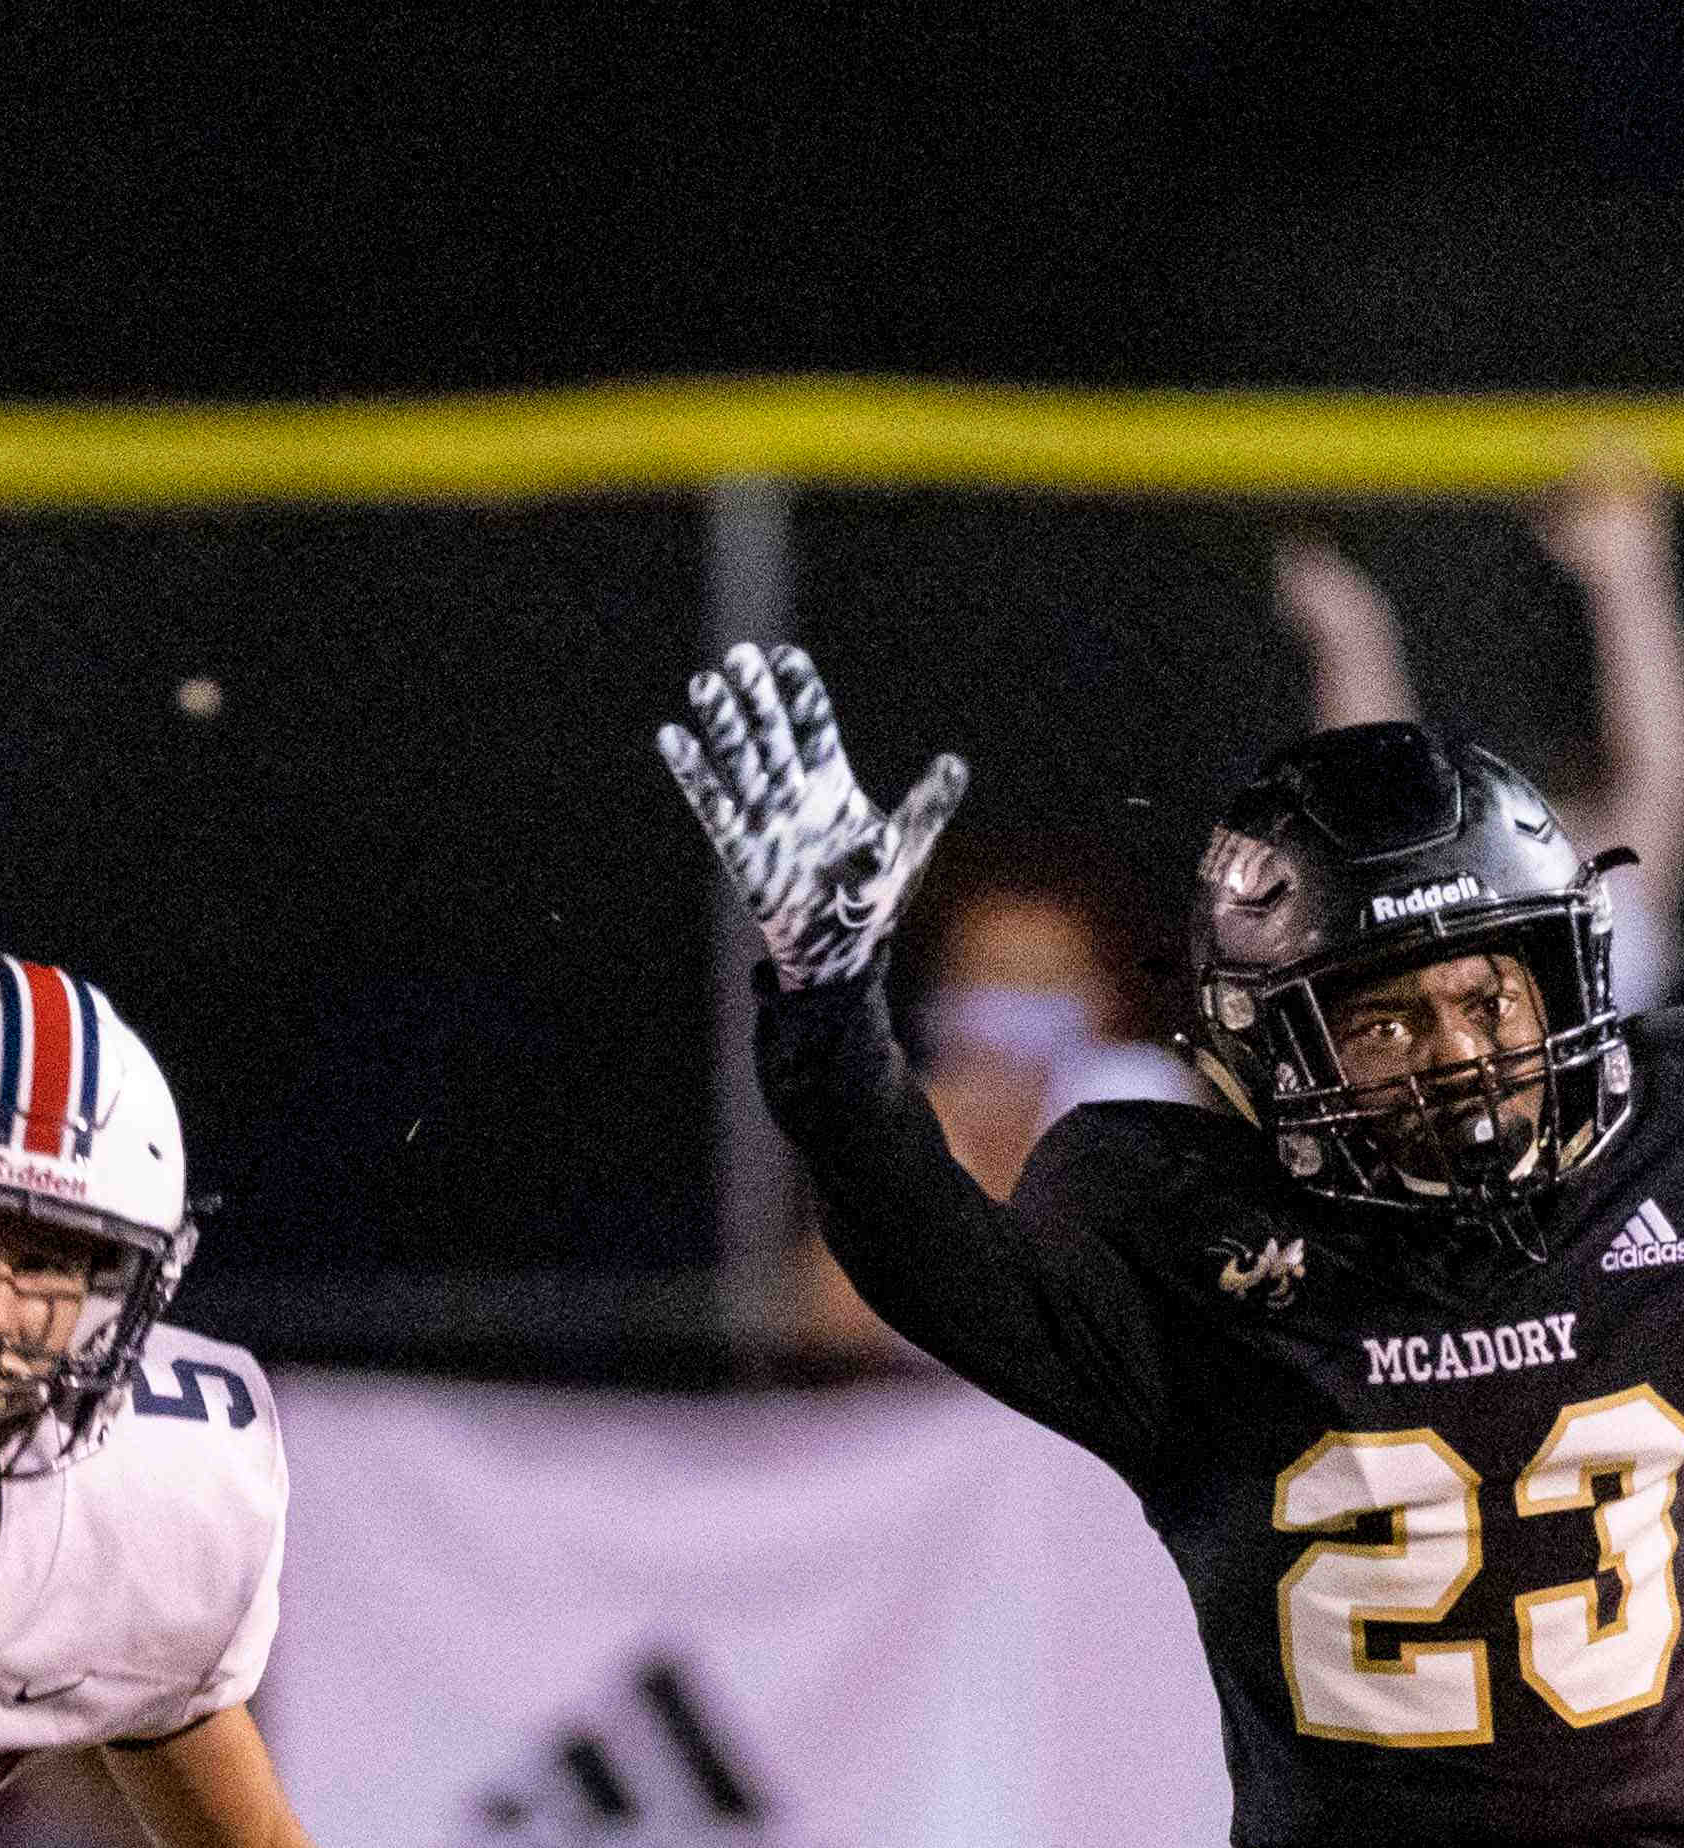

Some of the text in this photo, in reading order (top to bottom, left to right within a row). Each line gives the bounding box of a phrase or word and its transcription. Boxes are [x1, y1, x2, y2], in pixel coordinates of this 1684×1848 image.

[1372, 877, 1480, 922] Riddell
[1362, 1312, 1578, 1385] MCADORY
[129, 1357, 258, 1430] 5
